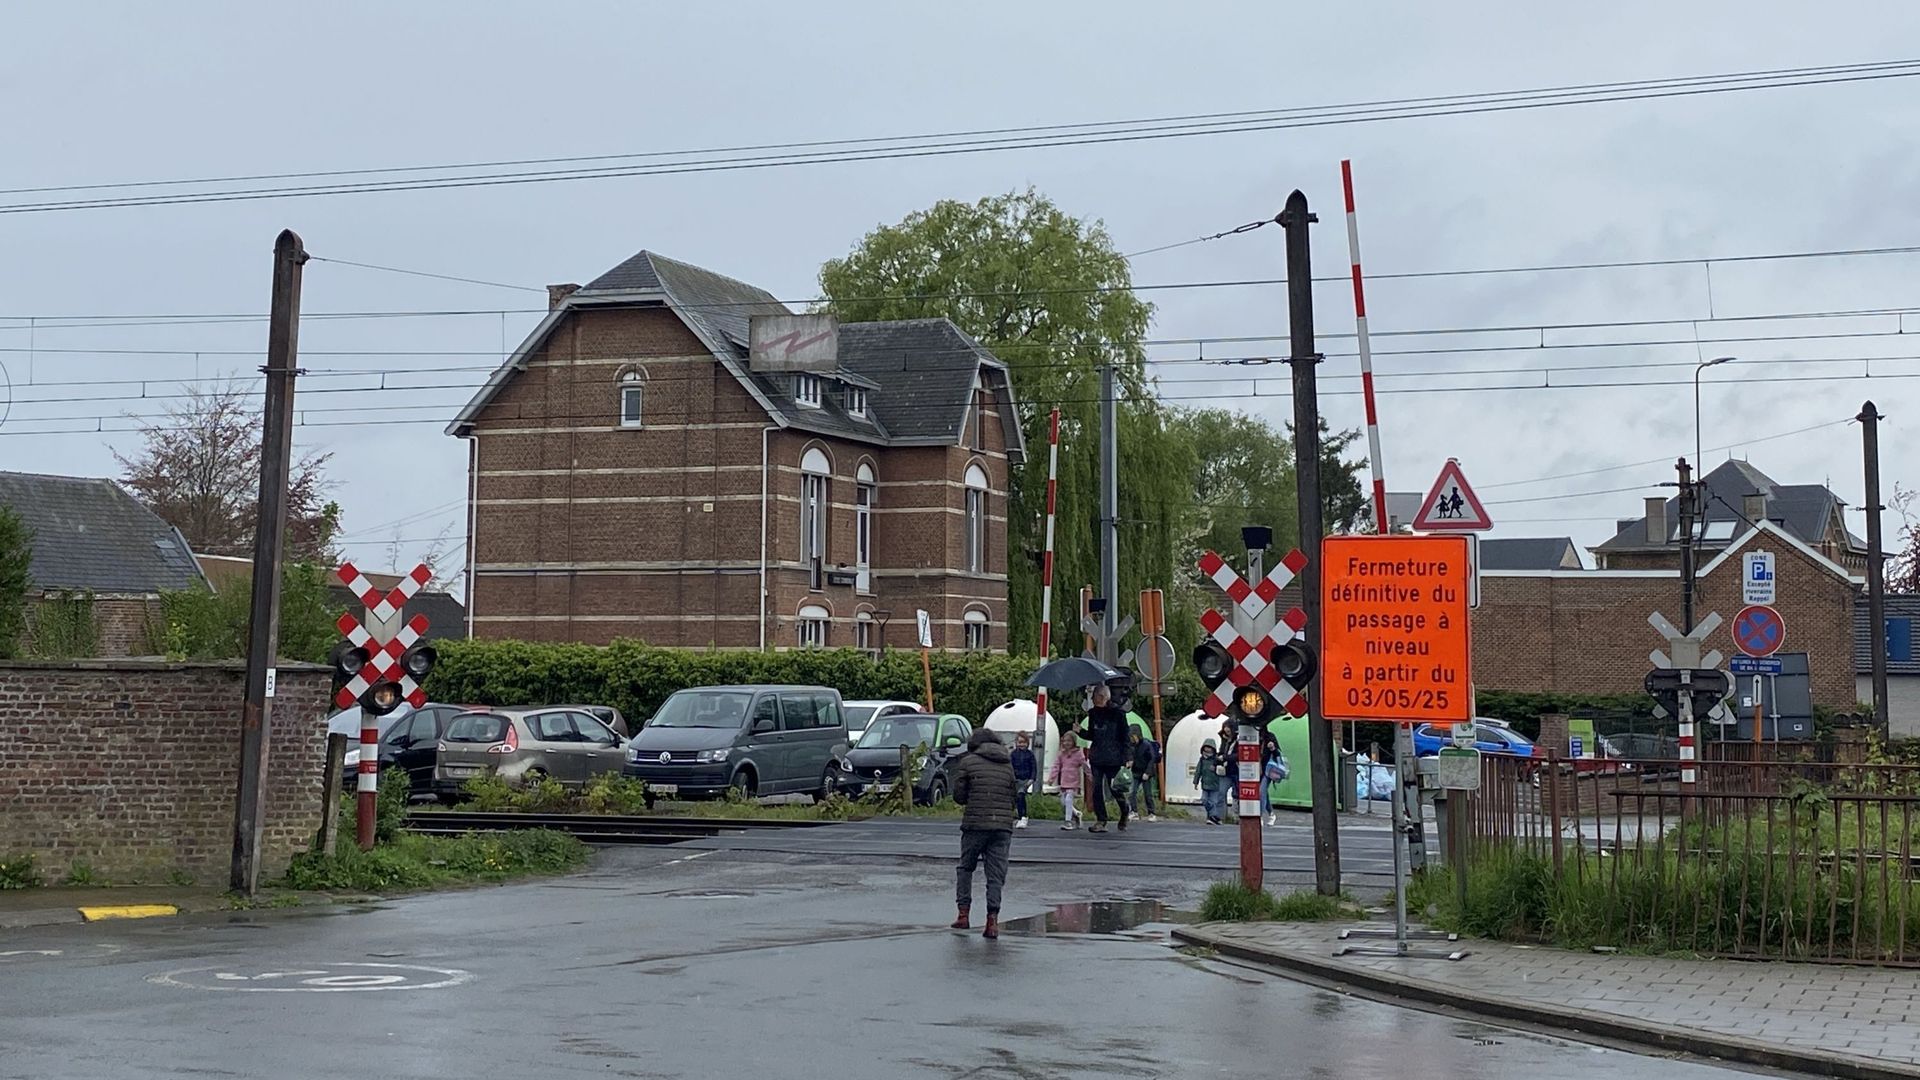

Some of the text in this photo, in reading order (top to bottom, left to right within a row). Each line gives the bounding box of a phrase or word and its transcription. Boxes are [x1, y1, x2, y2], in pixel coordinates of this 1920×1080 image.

[1348, 557, 1448, 576] Fermeture
[1754, 564, 1764, 579] P
[1331, 583, 1456, 603] définitive du
[1347, 612, 1449, 634] passage à
[1366, 636, 1429, 655] niveau
[1342, 663, 1455, 685] à partir du
[1347, 688, 1449, 709] 03/05/25
